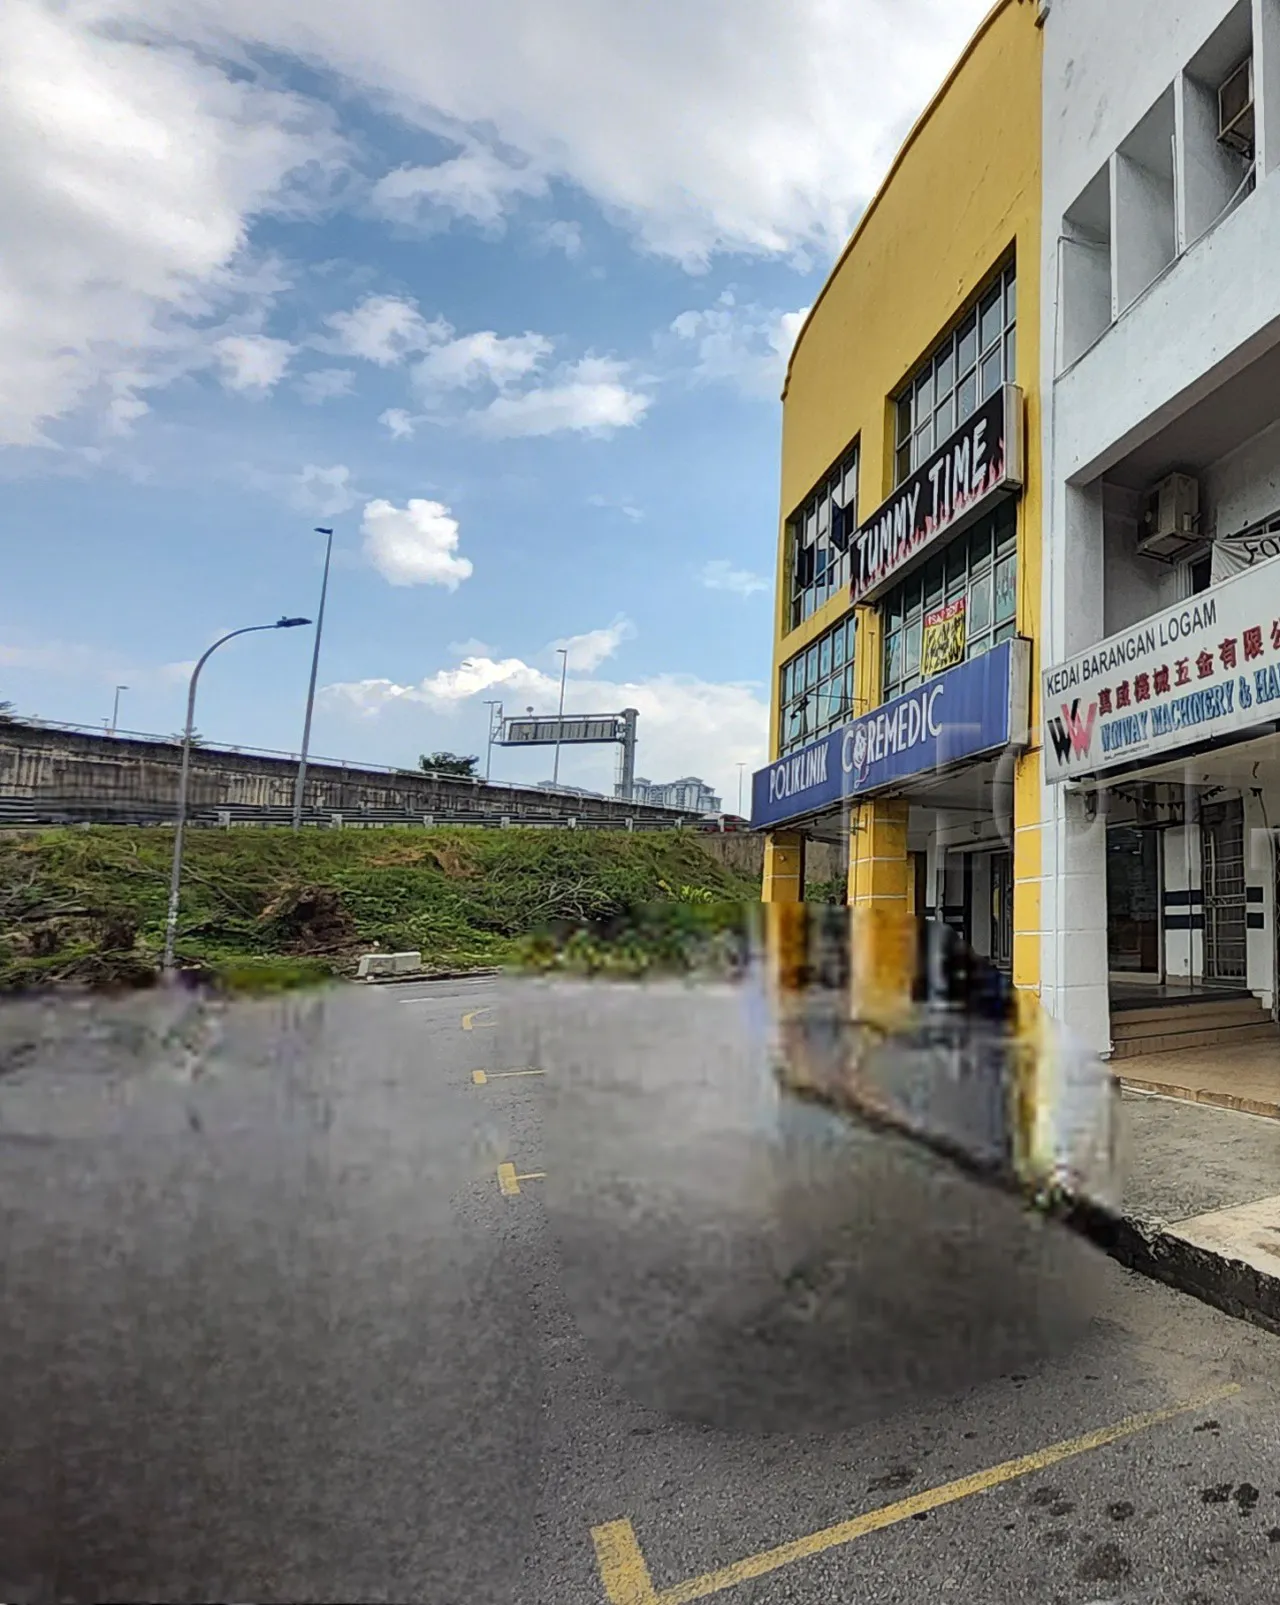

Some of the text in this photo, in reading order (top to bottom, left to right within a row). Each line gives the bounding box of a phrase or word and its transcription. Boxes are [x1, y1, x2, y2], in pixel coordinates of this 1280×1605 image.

[857, 418, 987, 591] TUMMY TIME
[1047, 598, 1217, 698] KEDAI BARANGAN LOGAM
[1150, 679, 1235, 738] MACHINERY
[1238, 676, 1253, 709] &
[769, 742, 829, 804] POLIKLINIK
